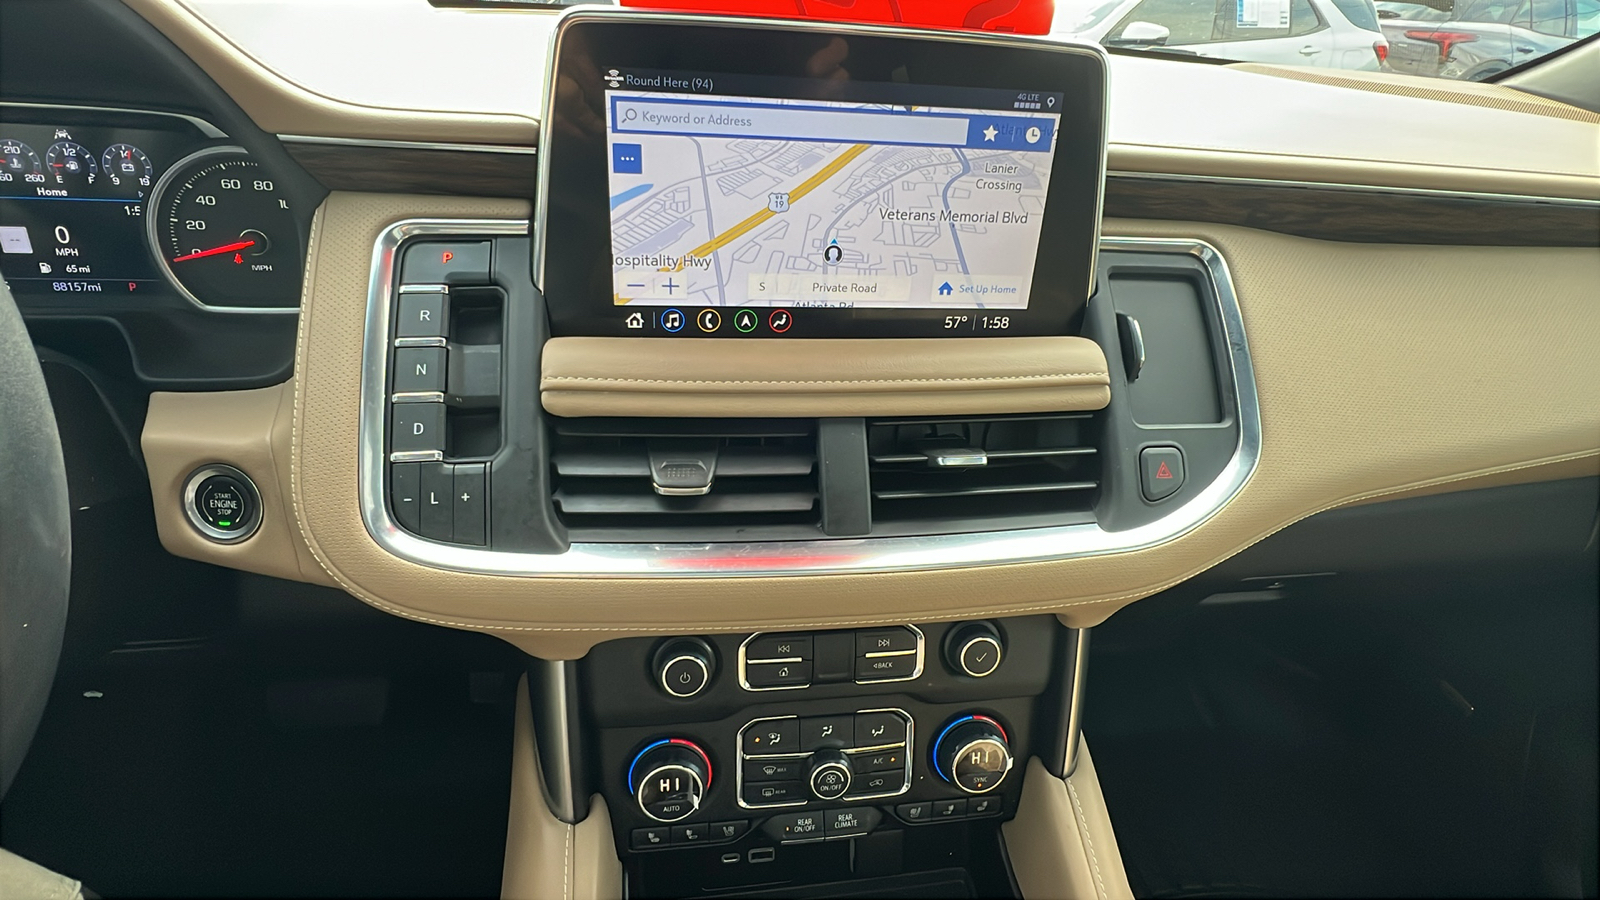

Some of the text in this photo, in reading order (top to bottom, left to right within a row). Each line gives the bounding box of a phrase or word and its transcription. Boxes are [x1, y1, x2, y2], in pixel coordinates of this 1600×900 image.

[626, 74, 661, 87] Round
[663, 76, 689, 88] Here
[692, 78, 714, 92] (94)
[642, 111, 752, 127] Keyword or Address
[3, 146, 21, 155] 210
[985, 163, 1018, 174] Lanier
[24, 174, 45, 182] 260
[87, 176, 95, 184] F
[112, 177, 120, 185] 9
[139, 177, 150, 186] 19
[221, 179, 241, 190] 60
[253, 181, 274, 191] 80
[975, 179, 1022, 193] Crossing
[37, 188, 68, 198] Home
[195, 195, 216, 206] 40
[775, 200, 784, 208] 19
[879, 208, 1029, 224] Veterans Memorial Blvd
[186, 220, 206, 231] 20
[54, 226, 70, 244] 0
[55, 248, 79, 257] MPH
[442, 252, 453, 264] P
[612, 254, 712, 270] ospitality Hwy
[66, 265, 91, 273] 65 mi
[251, 264, 273, 272] MPH
[52, 282, 102, 292] 88157mi
[128, 282, 137, 292] P
[759, 282, 766, 292] S
[812, 283, 877, 294] Private Road
[959, 284, 1017, 295] Set Up Home
[419, 310, 430, 321] R
[982, 316, 1010, 329] 1:58
[416, 364, 427, 375] N
[413, 422, 424, 435] D
[430, 492, 439, 504] L
[210, 500, 238, 509] ENGINE
[878, 661, 893, 669] BACK
[873, 757, 884, 765] A/C
[971, 751, 989, 765] HI
[660, 778, 680, 792] HI
[820, 784, 842, 792] ON/OFF
[663, 805, 680, 813] AUTO
[797, 818, 812, 826] REAR
[838, 814, 853, 822] REAR
[834, 820, 858, 829] CLIMATE
